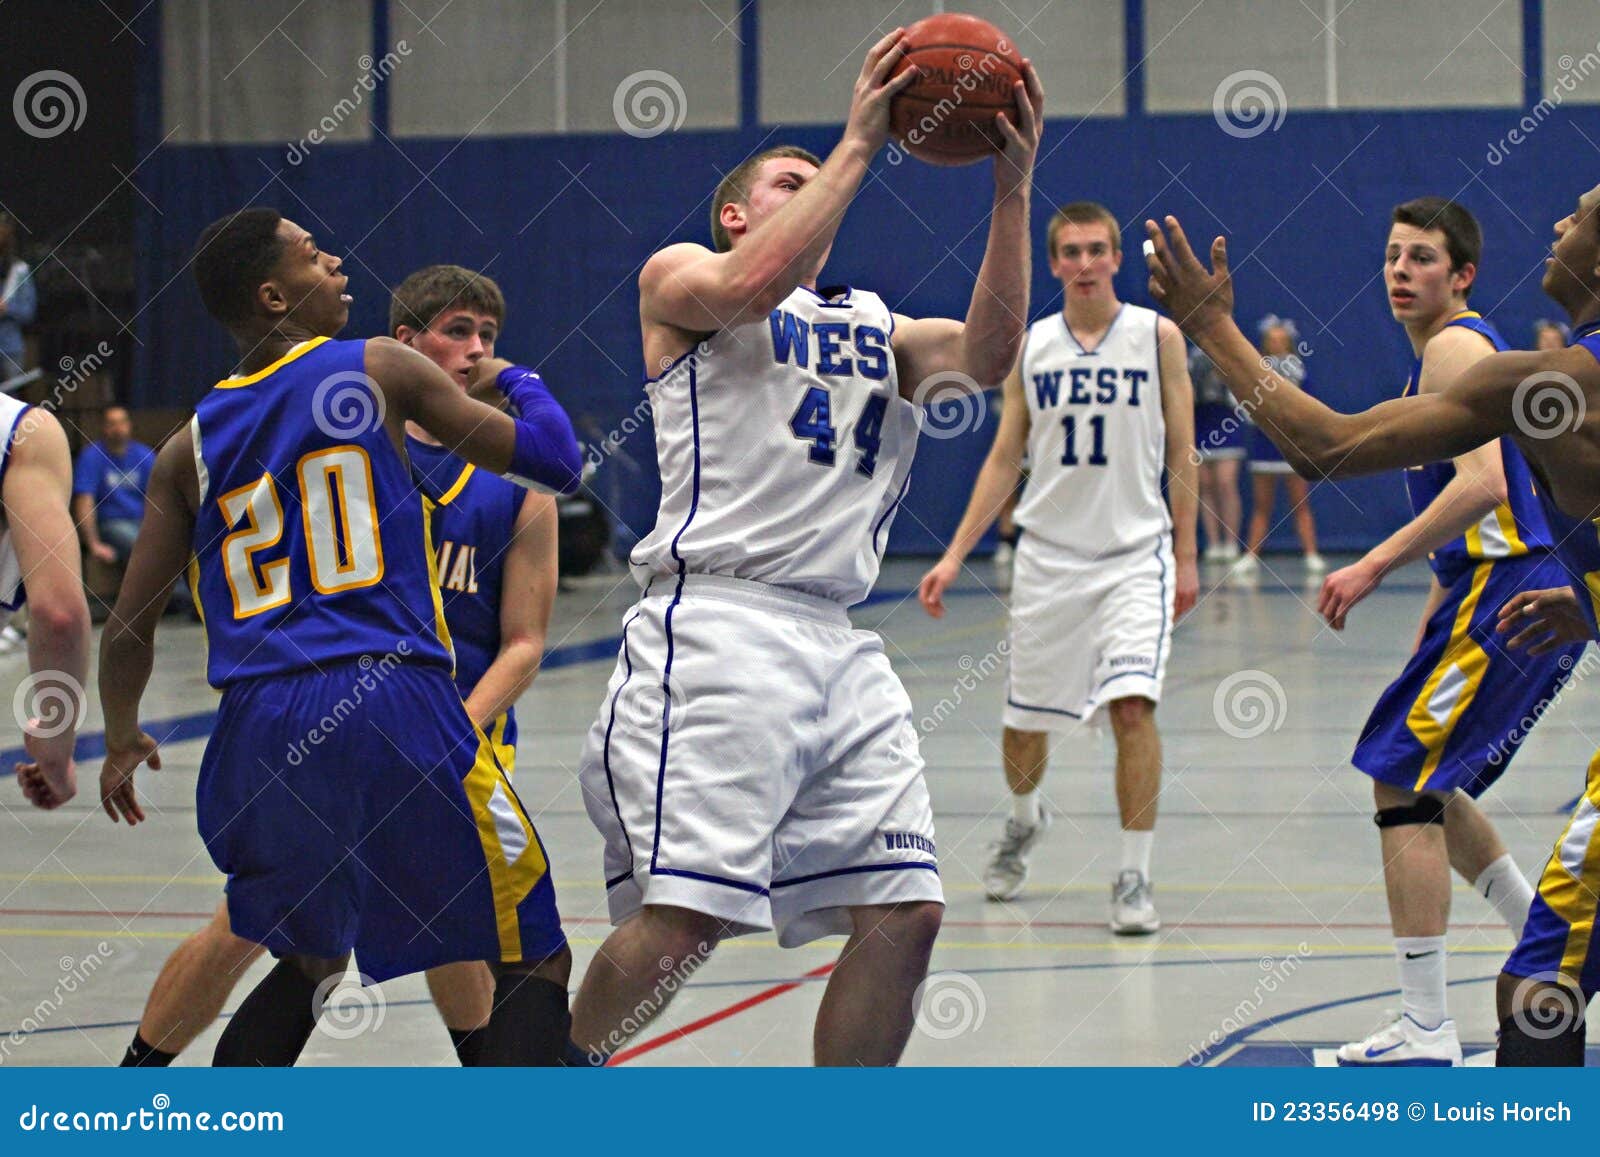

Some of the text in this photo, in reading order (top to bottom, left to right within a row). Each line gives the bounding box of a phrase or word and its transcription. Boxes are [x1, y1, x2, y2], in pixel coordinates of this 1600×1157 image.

[1033, 368, 1148, 410] WEST
[788, 387, 890, 480] 44
[1061, 415, 1107, 466] 11
[217, 445, 385, 620] 20
[435, 541, 478, 593] IAL
